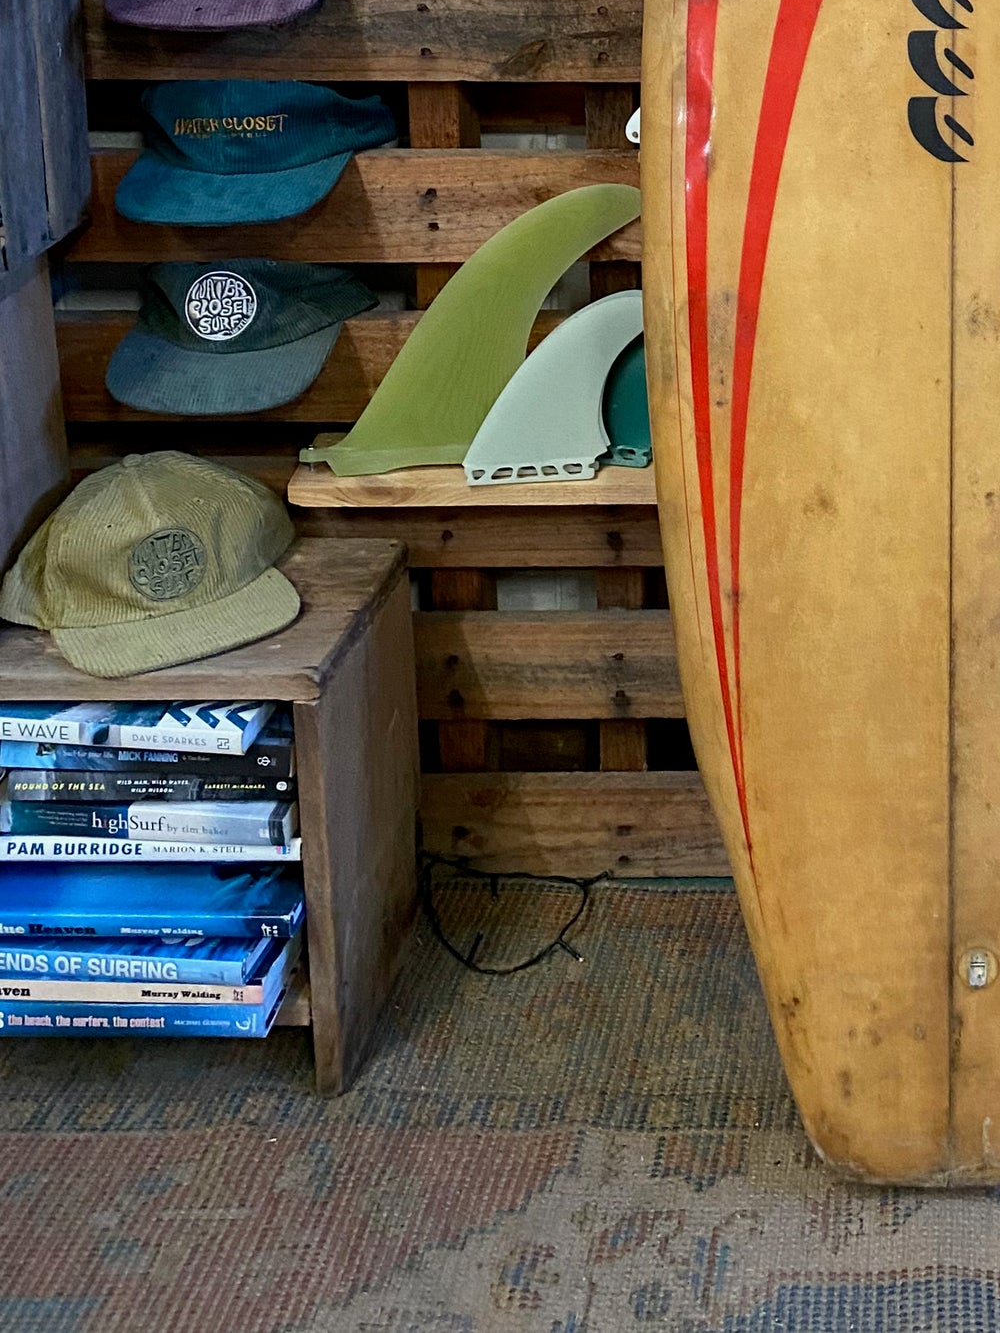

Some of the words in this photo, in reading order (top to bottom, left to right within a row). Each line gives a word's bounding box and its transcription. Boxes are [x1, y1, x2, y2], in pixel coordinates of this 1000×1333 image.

[222, 114, 288, 133] CLOSET
[192, 276, 248, 300] WATER
[189, 295, 252, 318] CLOSET
[199, 314, 243, 334] SURF
[17, 722, 69, 741] WAVE
[132, 733, 158, 743] DAVE
[162, 735, 207, 747] SPARKES
[117, 750, 141, 761] MICK
[143, 751, 178, 763] FANNING
[14, 783, 49, 791] HOUND
[51, 783, 65, 791] OF
[67, 783, 86, 791] THE
[88, 783, 105, 791] SEA
[167, 821, 177, 834] by
[181, 822, 199, 834] tim
[202, 823, 229, 835] baker
[6, 842, 44, 855] PAM
[53, 842, 143, 856] BURRIDGE
[152, 845, 196, 853] MARION
[28, 923, 97, 935] Heaven
[120, 927, 160, 935] Murray
[160, 927, 204, 936] Walding
[54, 955, 82, 974] OF
[87, 957, 178, 980] SURFING
[141, 990, 179, 999] Murray
[180, 990, 222, 1000] Walding
[8, 1015, 22, 1026] the
[56, 1015, 71, 1027] the
[113, 1016, 128, 1027] the
[129, 1016, 165, 1028] contest
